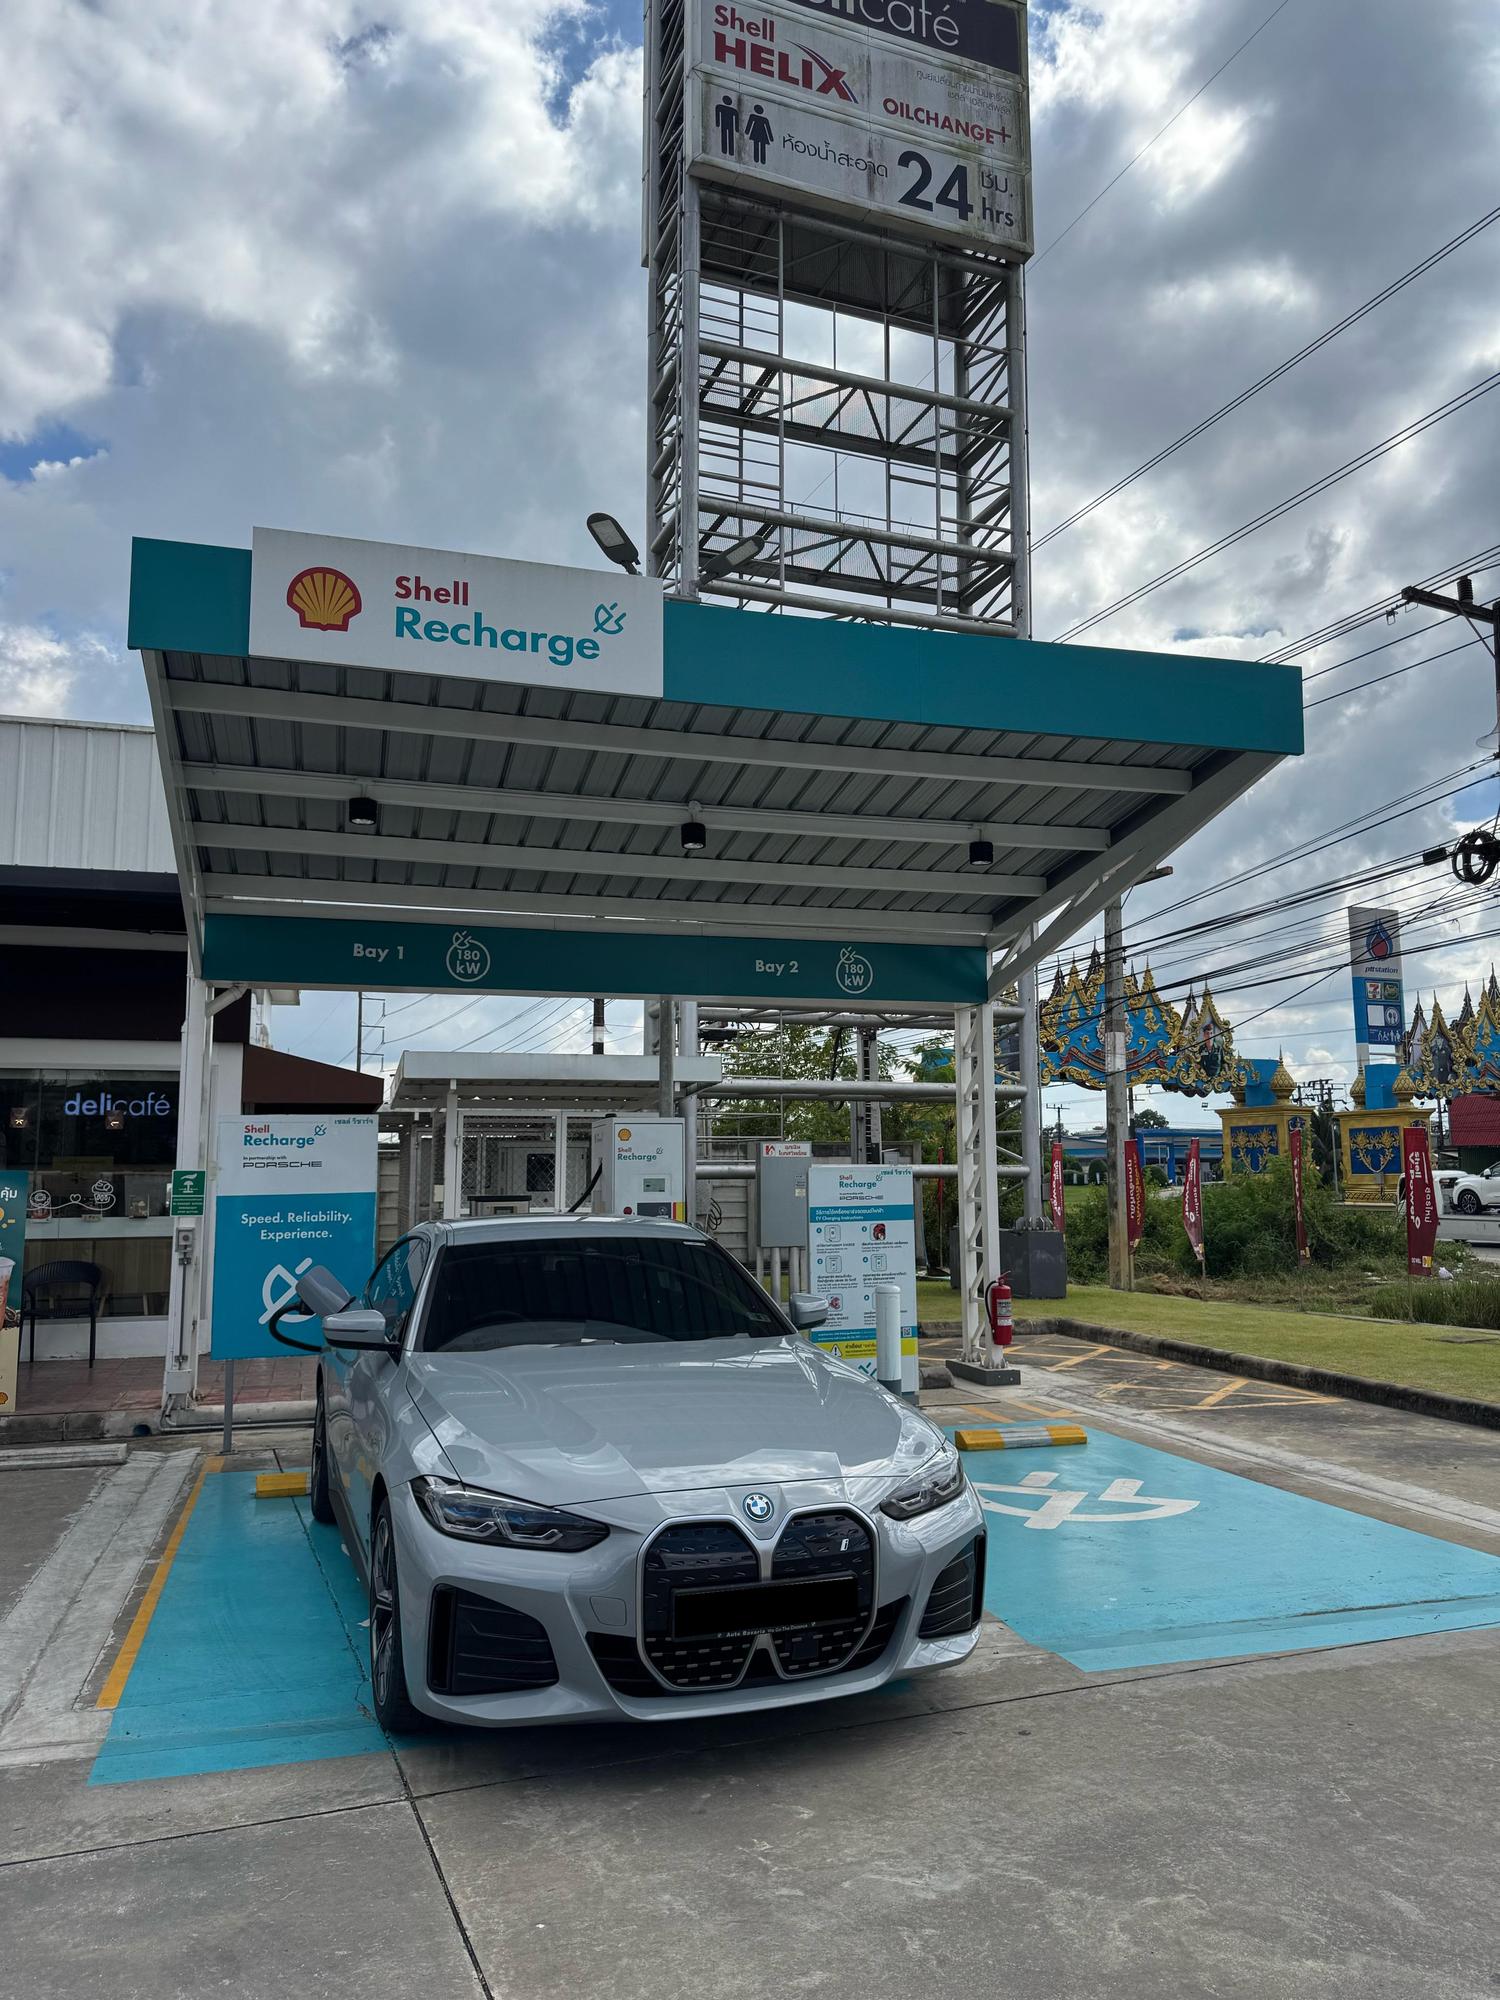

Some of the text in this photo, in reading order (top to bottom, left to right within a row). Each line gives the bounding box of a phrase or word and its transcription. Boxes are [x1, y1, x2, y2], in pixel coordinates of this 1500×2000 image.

[714, 5, 775, 42] Shell
[714, 31, 859, 104] HELIX
[782, 133, 888, 178] ห้องน้ำสะอาด
[898, 150, 974, 221] 24
[982, 197, 1014, 227] hrs
[395, 576, 469, 606] Shell
[395, 606, 601, 666] Recharge
[353, 943, 404, 962] Bay 1
[457, 949, 480, 961] 180
[456, 961, 480, 974] kW
[755, 960, 799, 976] Bay 2
[844, 964, 864, 974] 180
[844, 974, 864, 986] kW
[64, 1092, 171, 1116] delicafé
[244, 1124, 270, 1133] Shell
[244, 1134, 315, 1148] Recharge
[617, 1153, 657, 1162] Recharge
[839, 1181, 877, 1189] Recharge
[241, 1211, 352, 1227] Speed. Reliability.
[260, 1228, 333, 1242] Experience.
